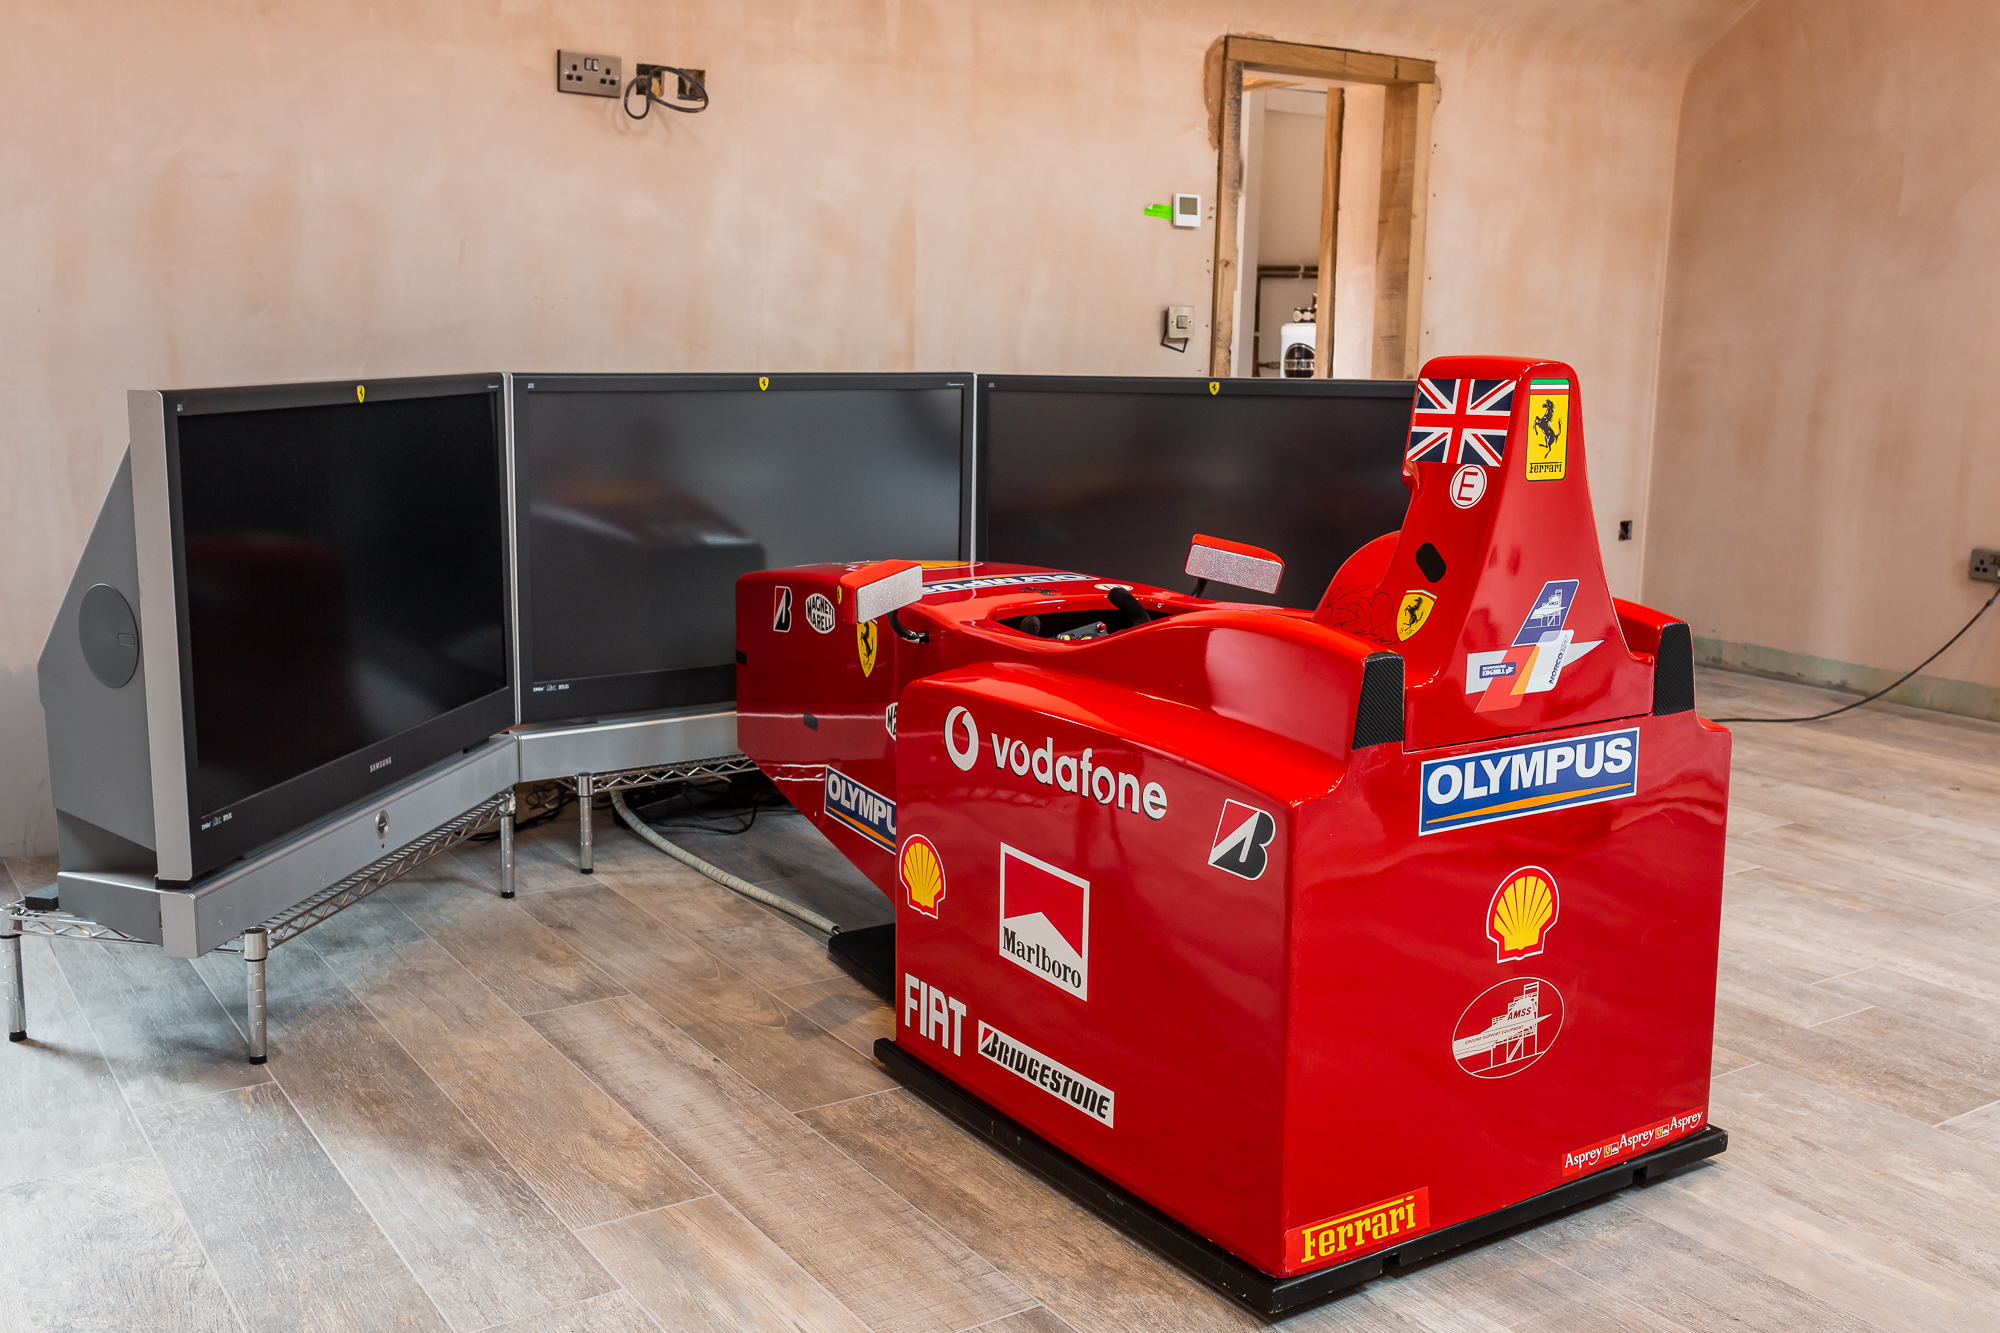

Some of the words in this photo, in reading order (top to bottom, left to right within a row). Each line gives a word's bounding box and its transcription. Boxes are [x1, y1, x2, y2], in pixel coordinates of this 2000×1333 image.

[1456, 470, 1479, 502] E
[1528, 461, 1562, 474] Ferrari
[369, 756, 392, 773] SAMSUNG
[991, 732, 1168, 820] vodafone
[1427, 737, 1632, 805] OLYMPUS
[827, 773, 897, 836] OLYMPU
[1002, 926, 1082, 989] Marlboro
[904, 972, 967, 1057] FIAT
[1507, 1006, 1532, 1021] AMSS
[981, 1028, 1111, 1120] BRIDGESTONE
[1564, 1146, 1603, 1170] Asprey
[1619, 1128, 1655, 1151] Asprey
[1669, 1111, 1703, 1132] Asprey
[1300, 1195, 1416, 1264] Ferrari
